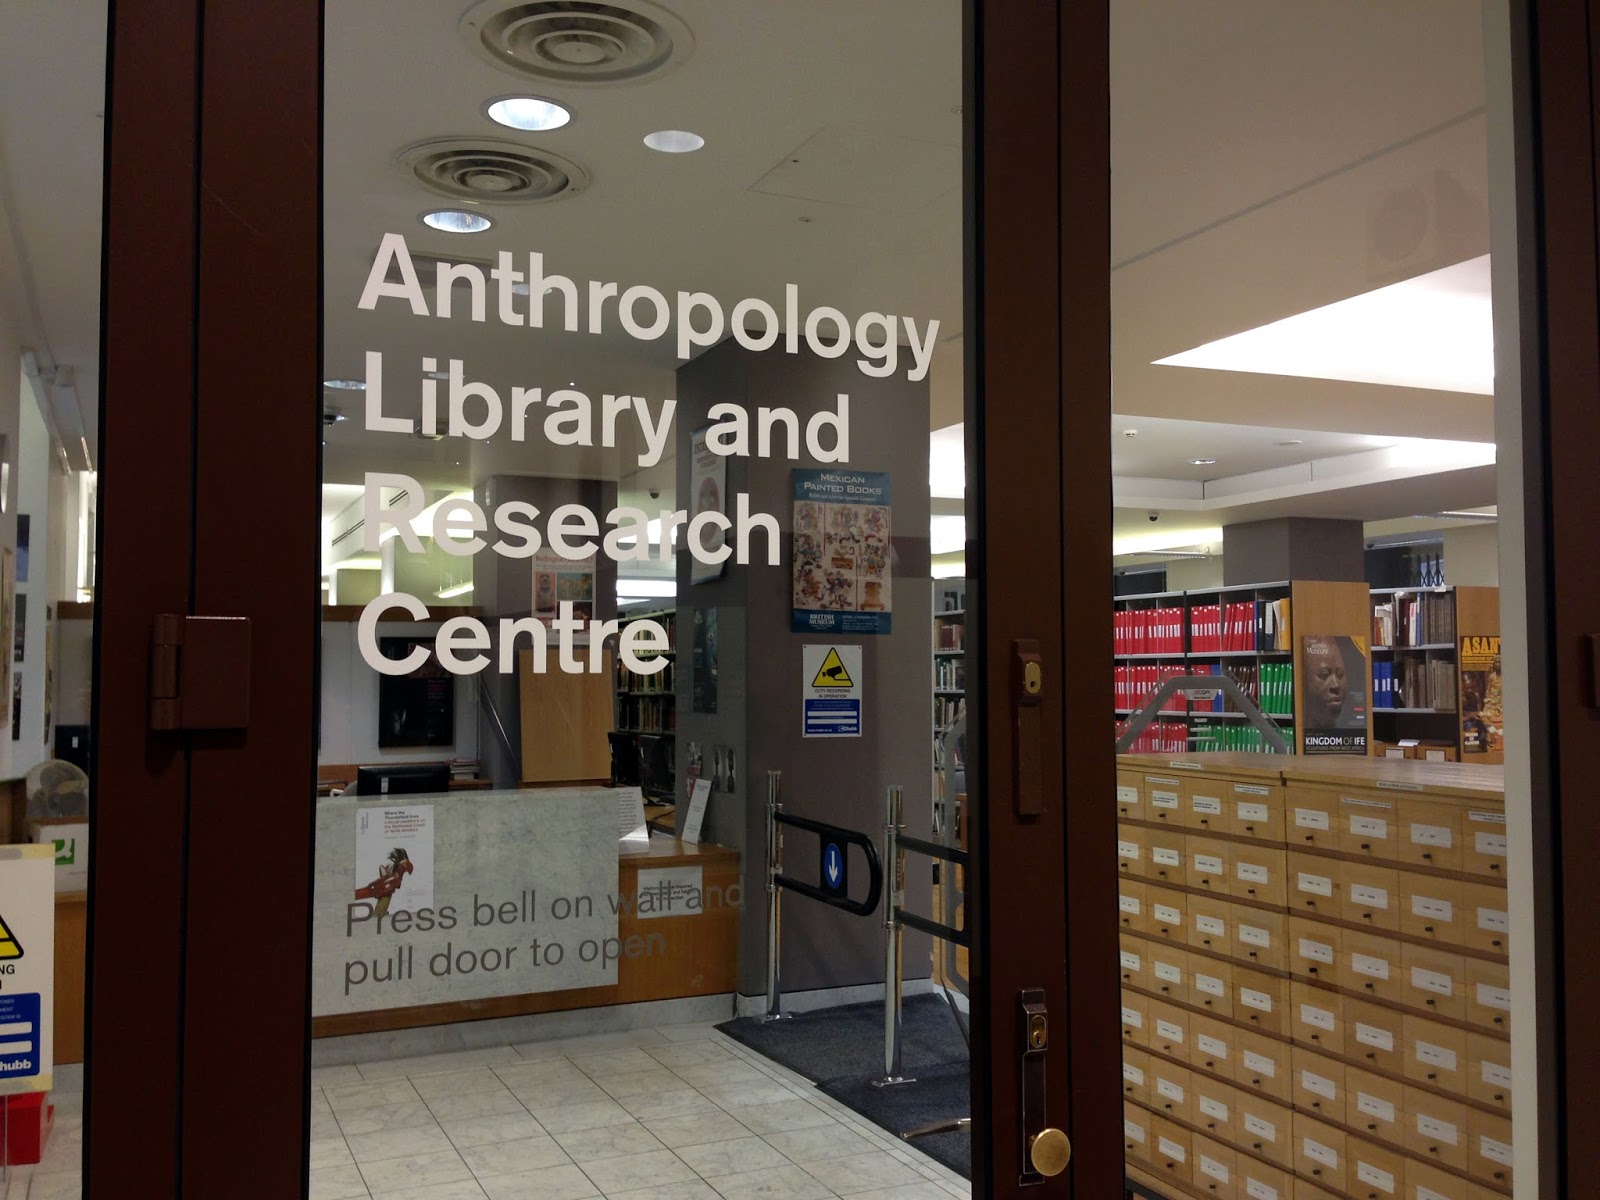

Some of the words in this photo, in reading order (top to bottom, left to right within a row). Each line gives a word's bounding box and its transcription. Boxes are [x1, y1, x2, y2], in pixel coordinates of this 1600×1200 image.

[358, 232, 940, 382] Anthropology
[365, 350, 677, 468] Library
[704, 393, 850, 464] and
[363, 472, 781, 567] Research
[357, 592, 670, 676] Centre
[1462, 636, 1501, 656] ASAN
[1305, 737, 1342, 745] KINGDOM
[1343, 737, 1353, 745] OF
[1354, 737, 1365, 745] IFE
[346, 902, 458, 938] Press
[473, 890, 536, 926] bell
[550, 893, 593, 920] on
[608, 880, 672, 915] wall
[685, 874, 745, 911] and
[344, 946, 412, 996] pull
[429, 942, 518, 978] door
[530, 938, 564, 968] to
[578, 932, 666, 970] open
